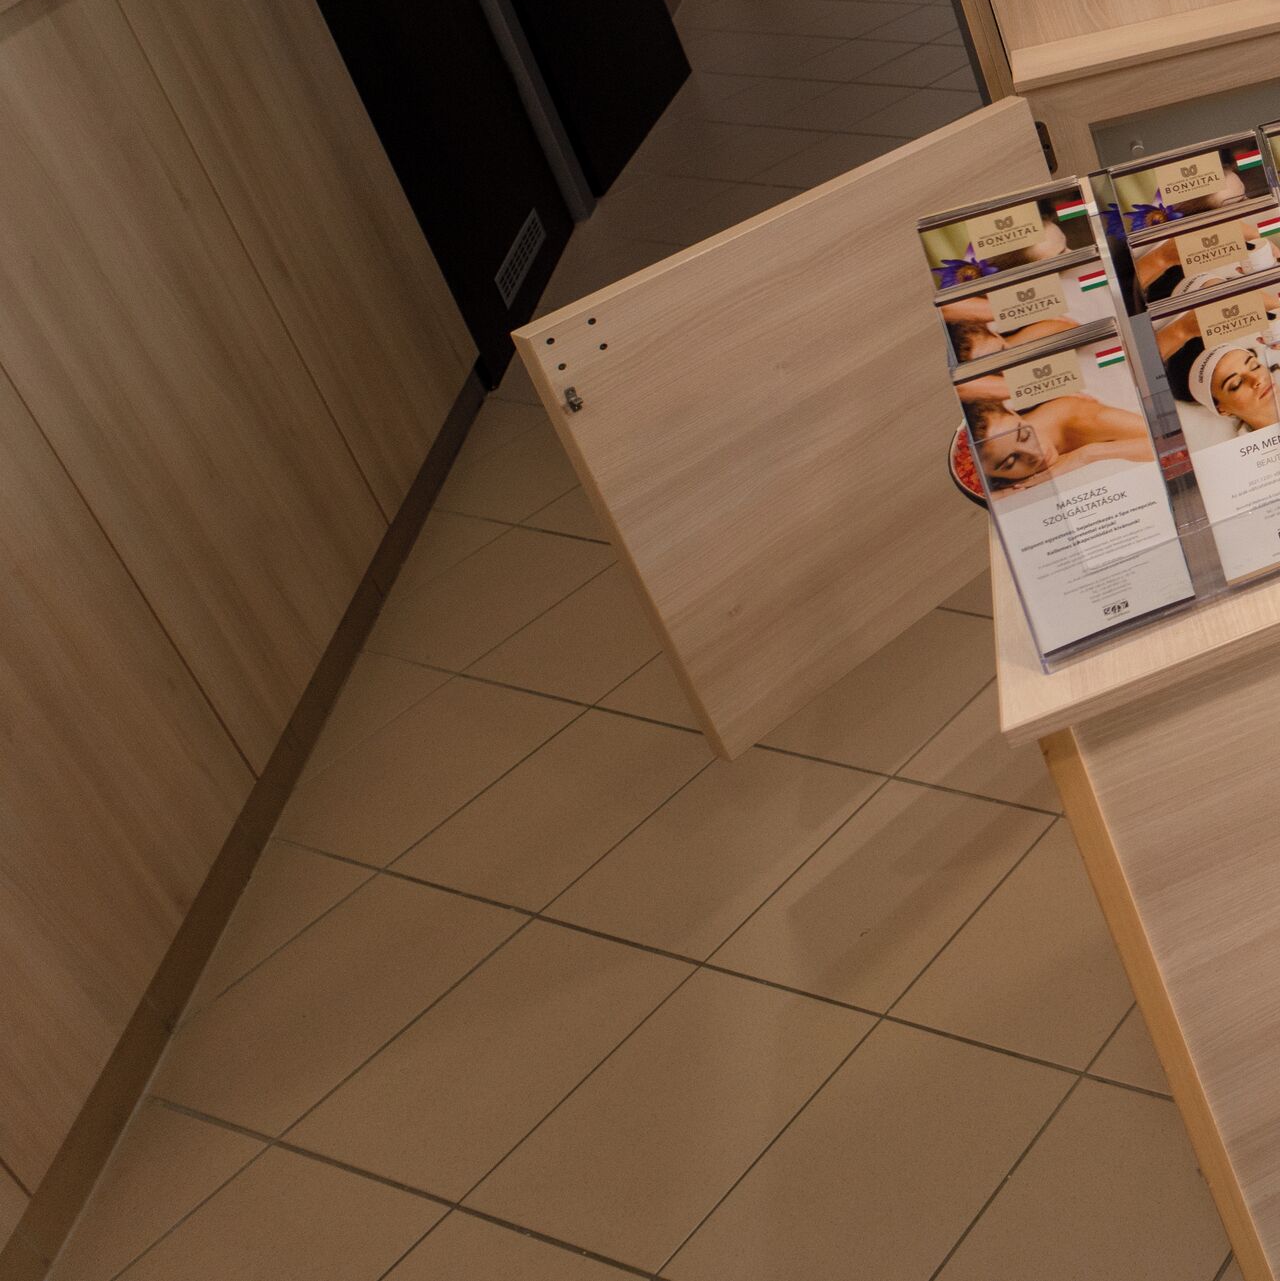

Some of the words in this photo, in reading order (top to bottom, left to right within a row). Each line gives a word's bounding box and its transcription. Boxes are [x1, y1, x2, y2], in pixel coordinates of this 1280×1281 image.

[1165, 174, 1221, 194] BONVITAL
[976, 224, 1040, 248] BONVITAL
[1185, 244, 1242, 265] BONVITAL
[999, 296, 1062, 320] BONVITAL
[1206, 313, 1263, 336] BONVITAL
[1015, 373, 1078, 398] BONVITAL
[1239, 442, 1260, 458] SPA
[1042, 491, 1128, 527] SZOLGÁLTATÁSOK
[1056, 485, 1108, 511] MASSZÁZS
